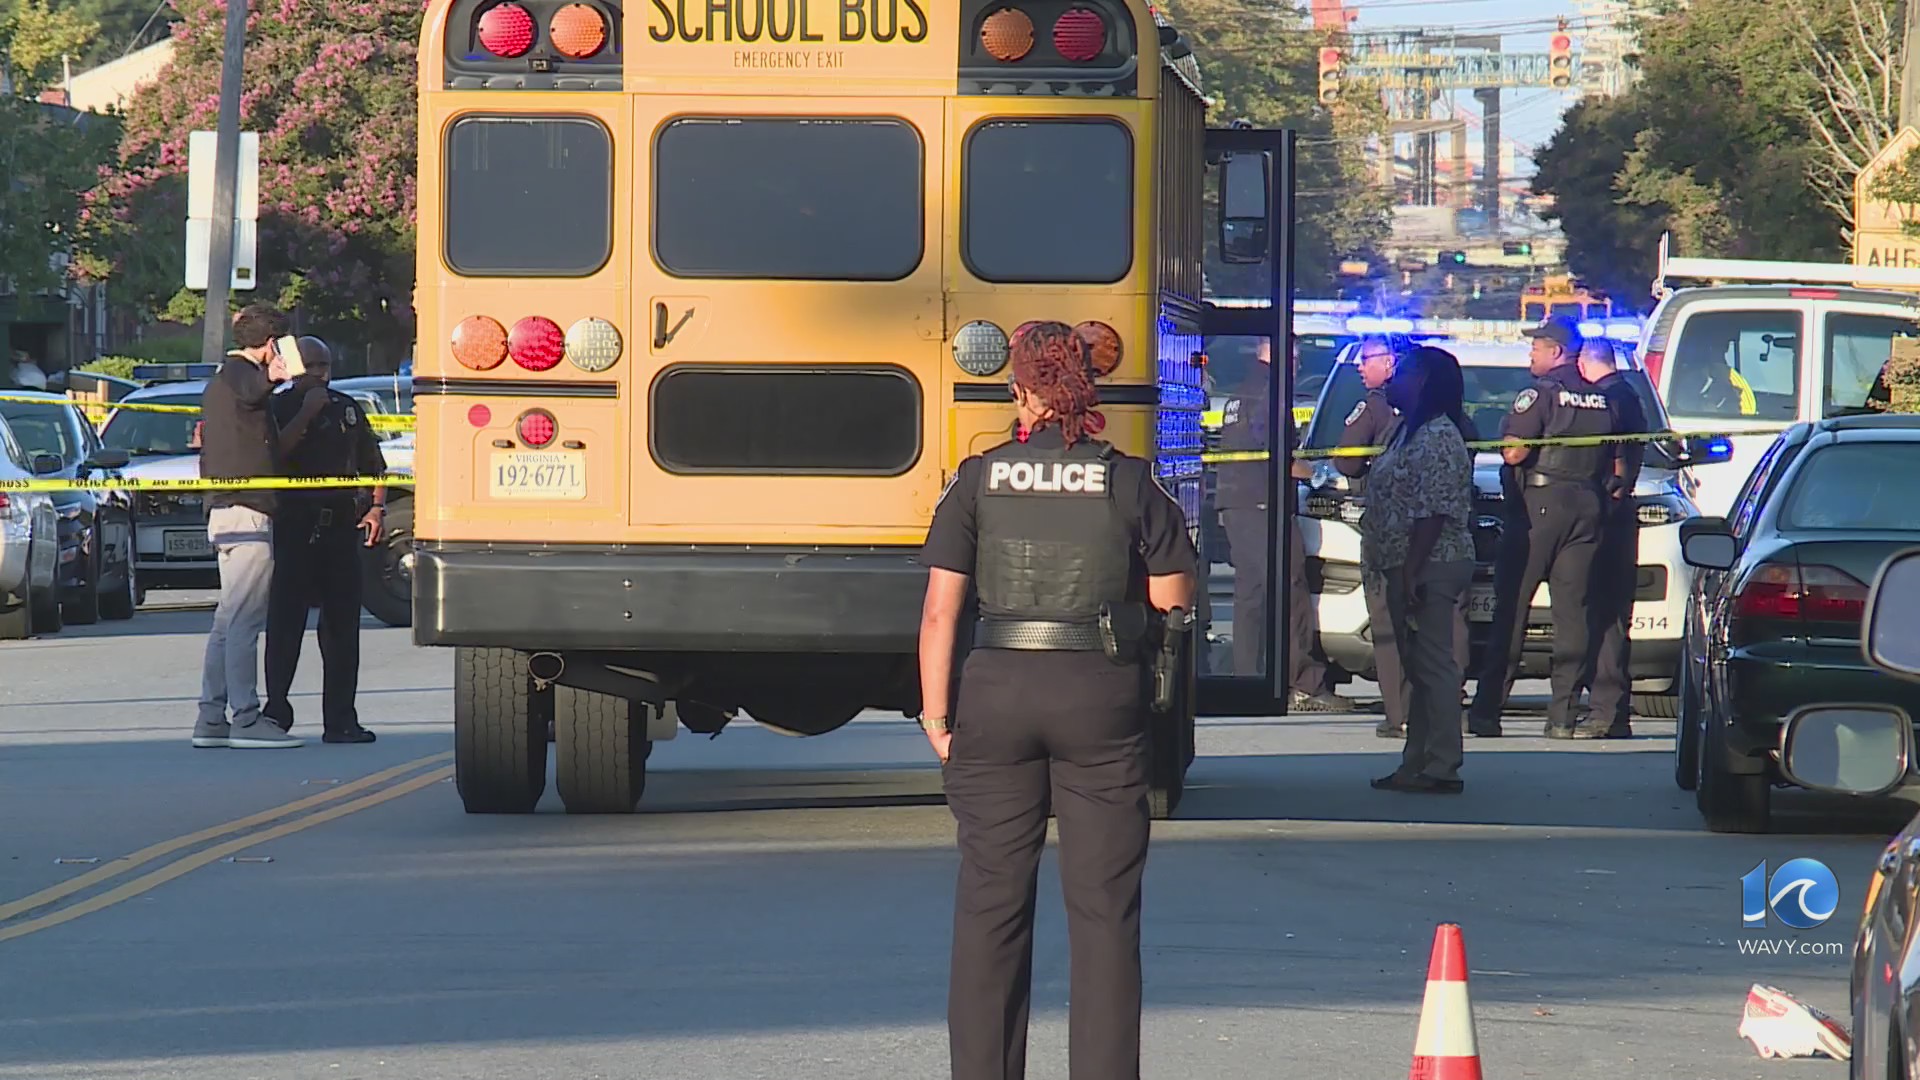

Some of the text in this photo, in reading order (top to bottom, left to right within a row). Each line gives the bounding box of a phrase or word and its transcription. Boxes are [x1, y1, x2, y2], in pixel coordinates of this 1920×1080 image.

[648, 0, 929, 43] SCHOOL BUS
[733, 51, 844, 68] EMERGENCY EXIT
[1559, 390, 1607, 409] POLICE
[515, 454, 561, 463] VIRGINIA
[989, 461, 1106, 493] POLICE
